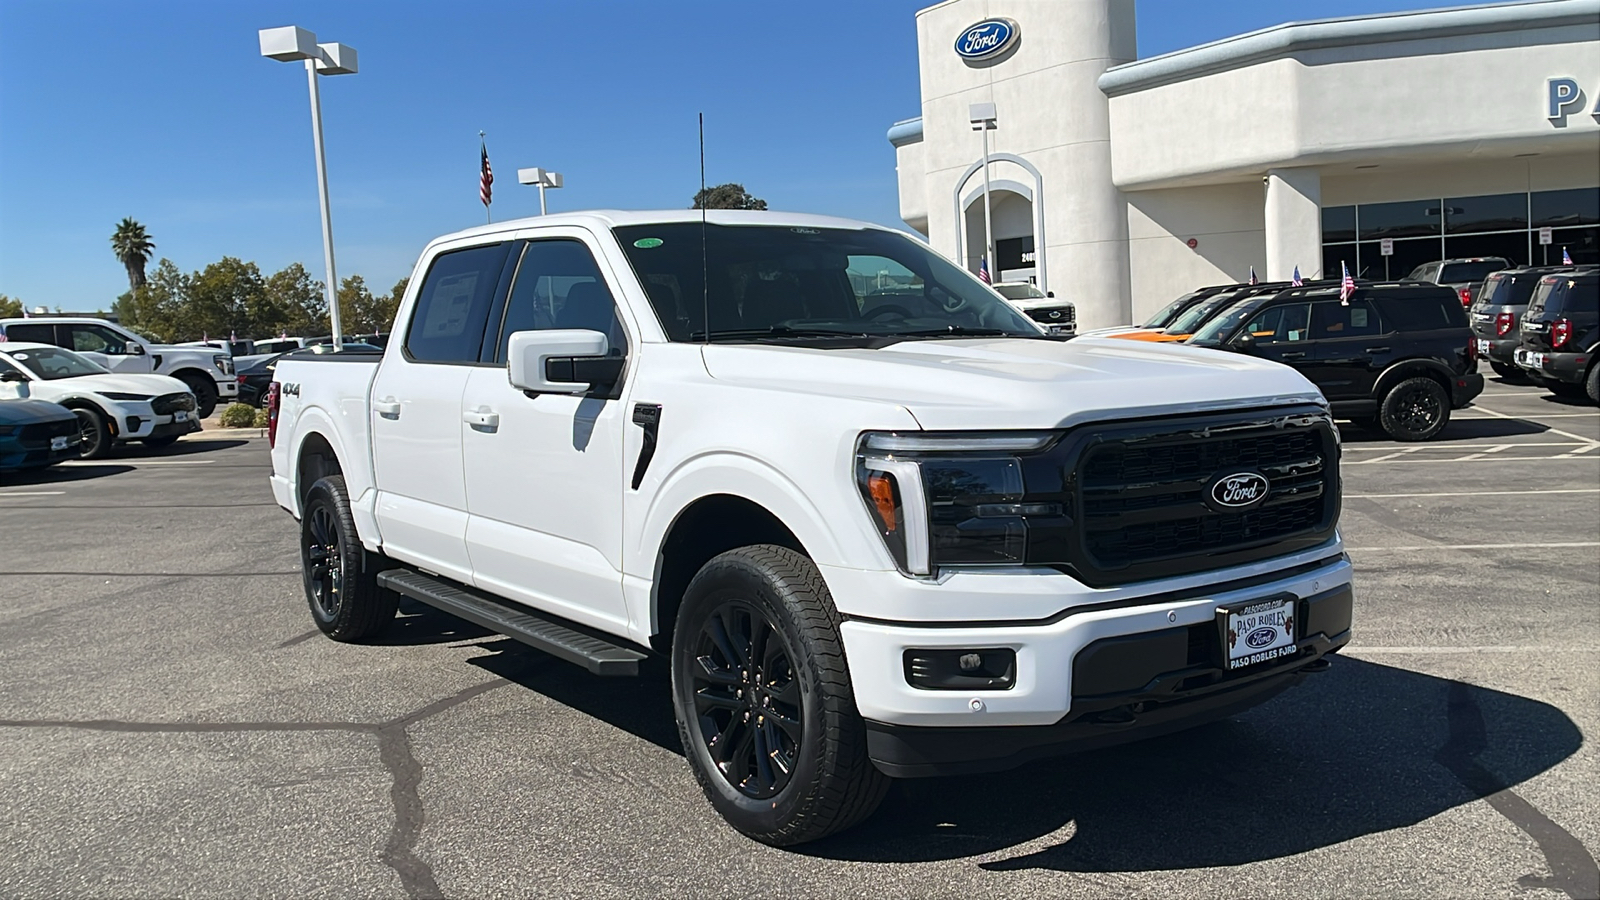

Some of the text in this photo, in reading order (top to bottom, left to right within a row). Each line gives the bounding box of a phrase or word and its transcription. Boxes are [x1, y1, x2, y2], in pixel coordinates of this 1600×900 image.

[965, 26, 999, 53] Ford
[1223, 478, 1258, 502] Ford
[1236, 610, 1286, 638] PASO ROBLES
[1252, 630, 1273, 646] Ford
[1230, 644, 1297, 670] PASO ROBLES FORD
